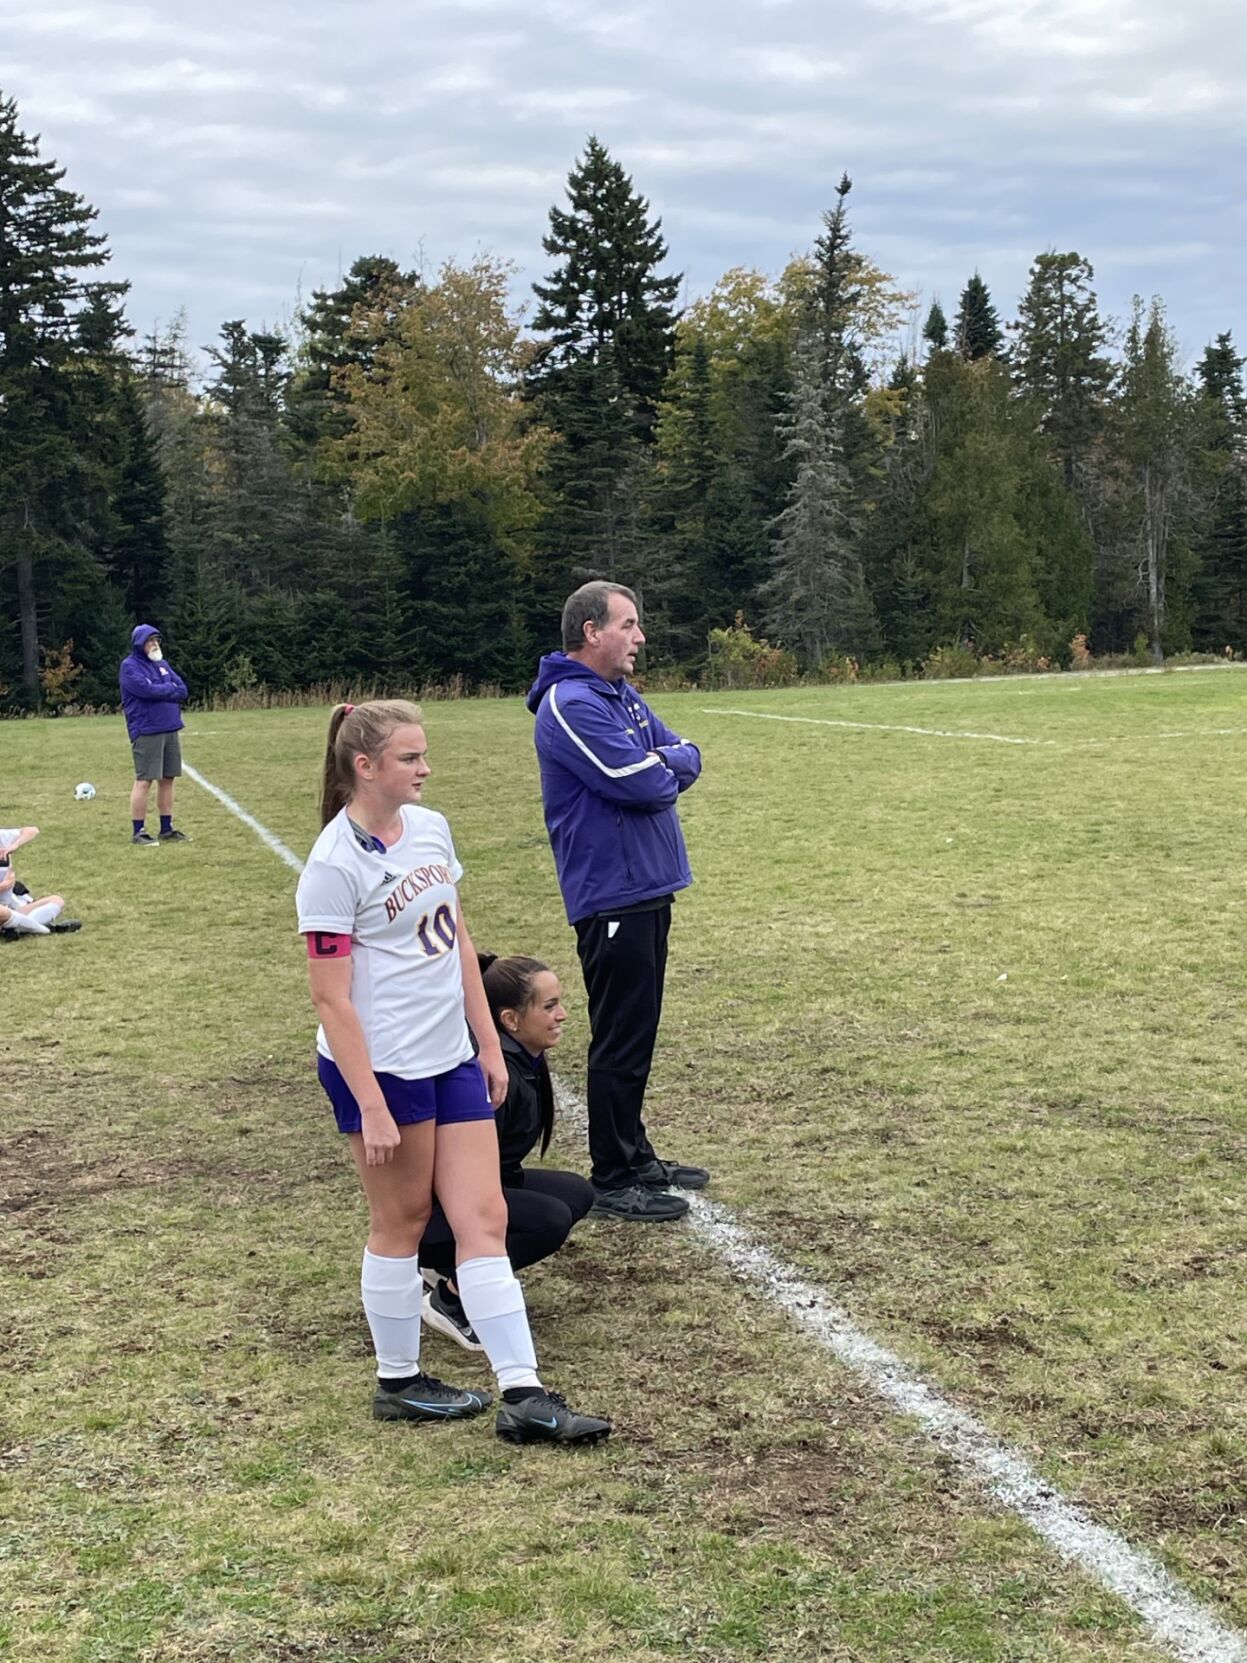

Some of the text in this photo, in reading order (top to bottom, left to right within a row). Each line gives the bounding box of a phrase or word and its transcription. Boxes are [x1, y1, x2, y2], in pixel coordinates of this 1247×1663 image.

[384, 864, 455, 924] BUCKSPOR
[315, 932, 338, 955] C
[417, 903, 457, 957] 10
